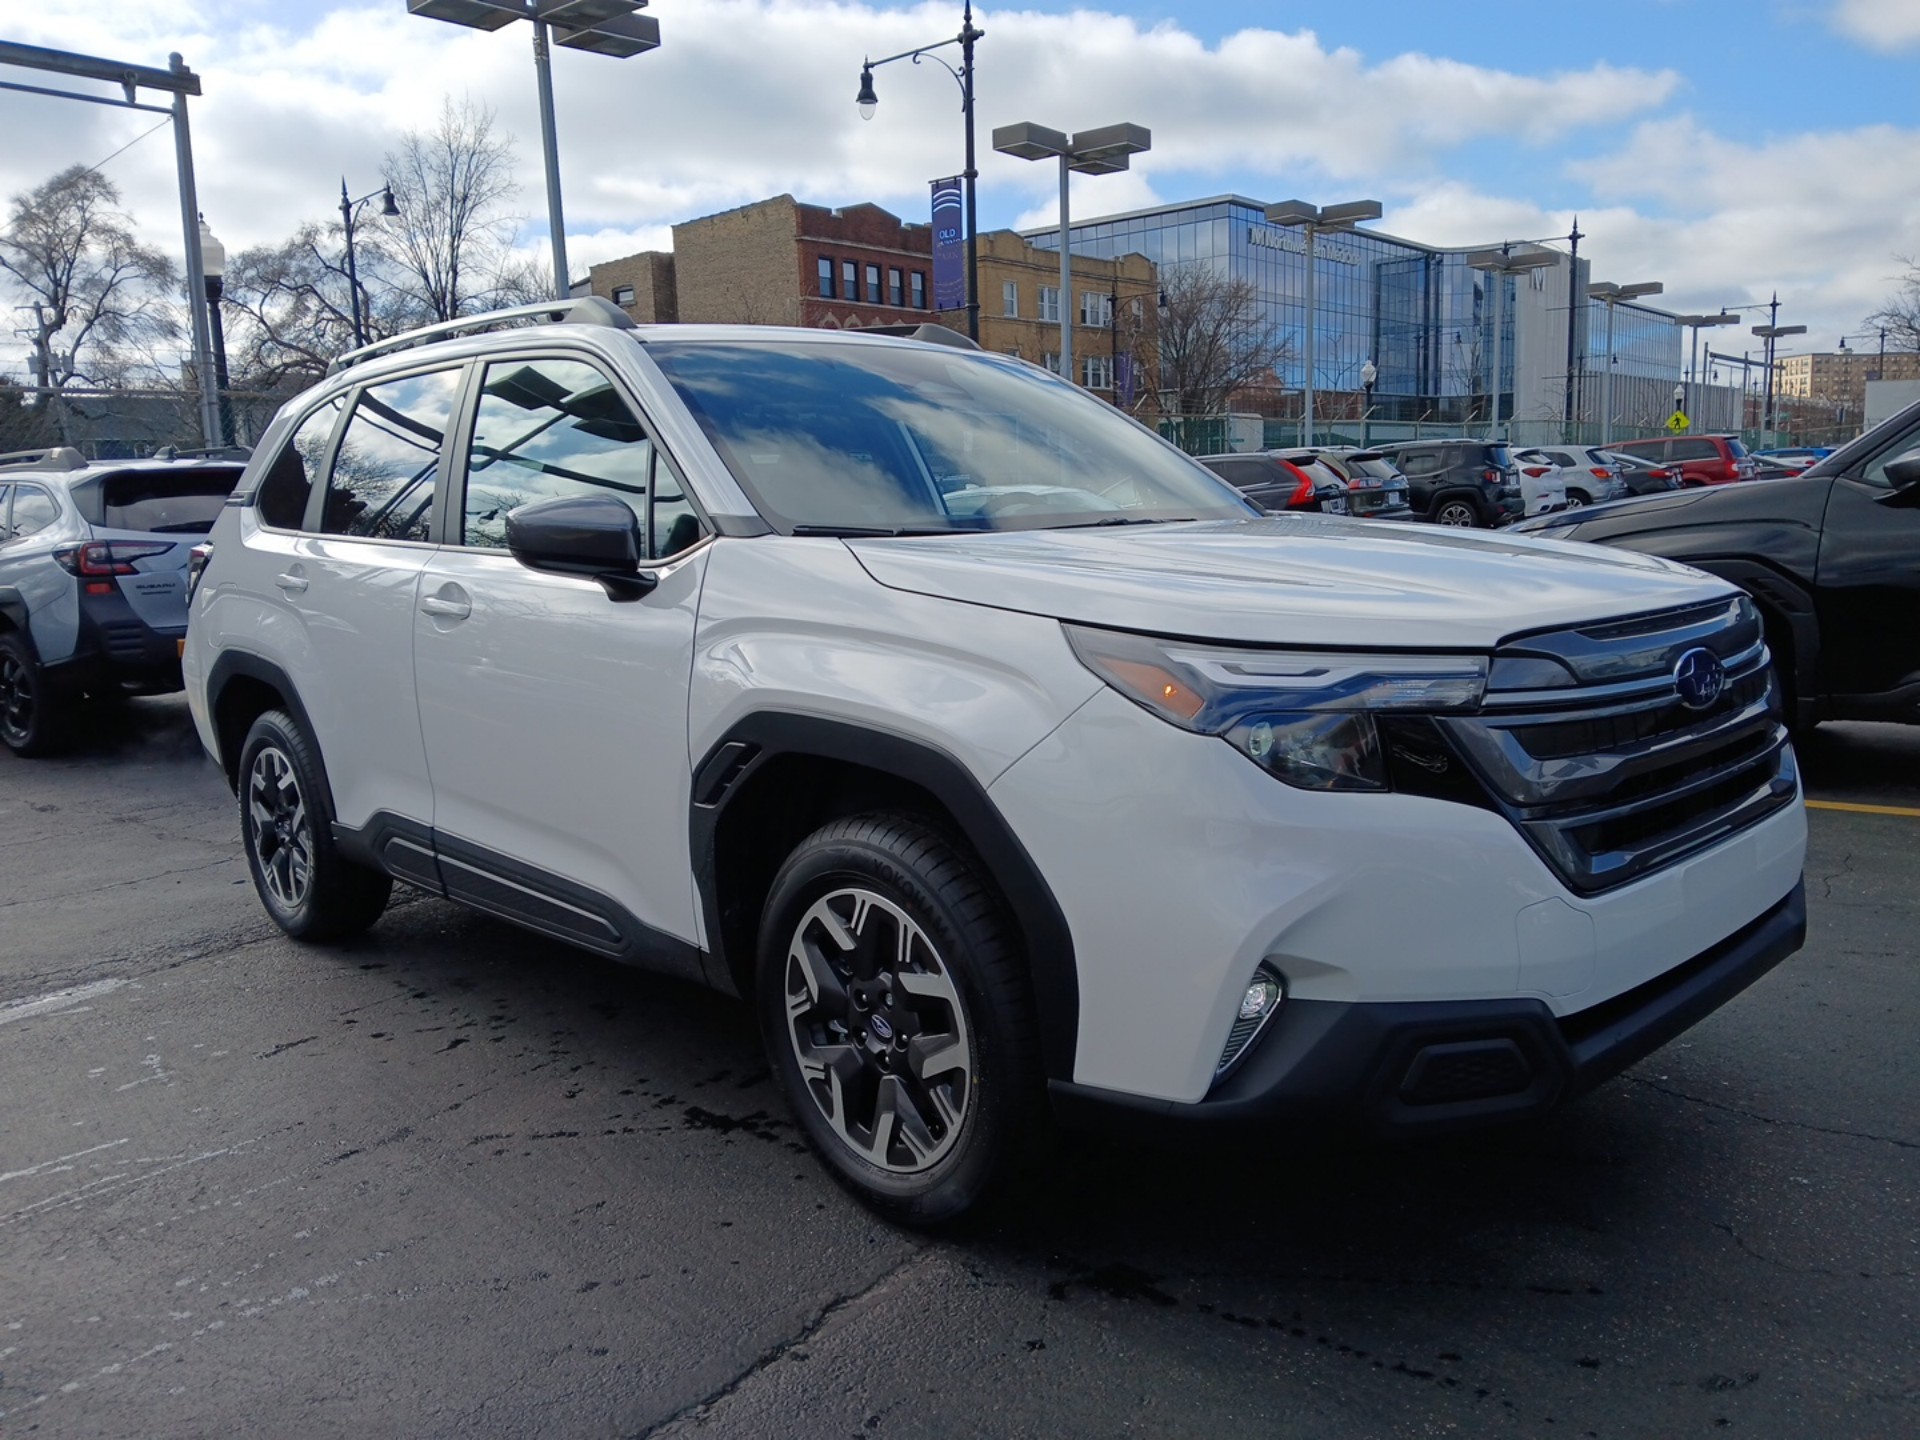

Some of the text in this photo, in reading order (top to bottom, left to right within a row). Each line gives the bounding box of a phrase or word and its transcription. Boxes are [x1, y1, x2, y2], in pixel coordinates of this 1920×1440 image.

[939, 228, 956, 239] OLD
[1265, 230, 1326, 259] Northweern
[873, 858, 957, 954] YOKOHAMA
